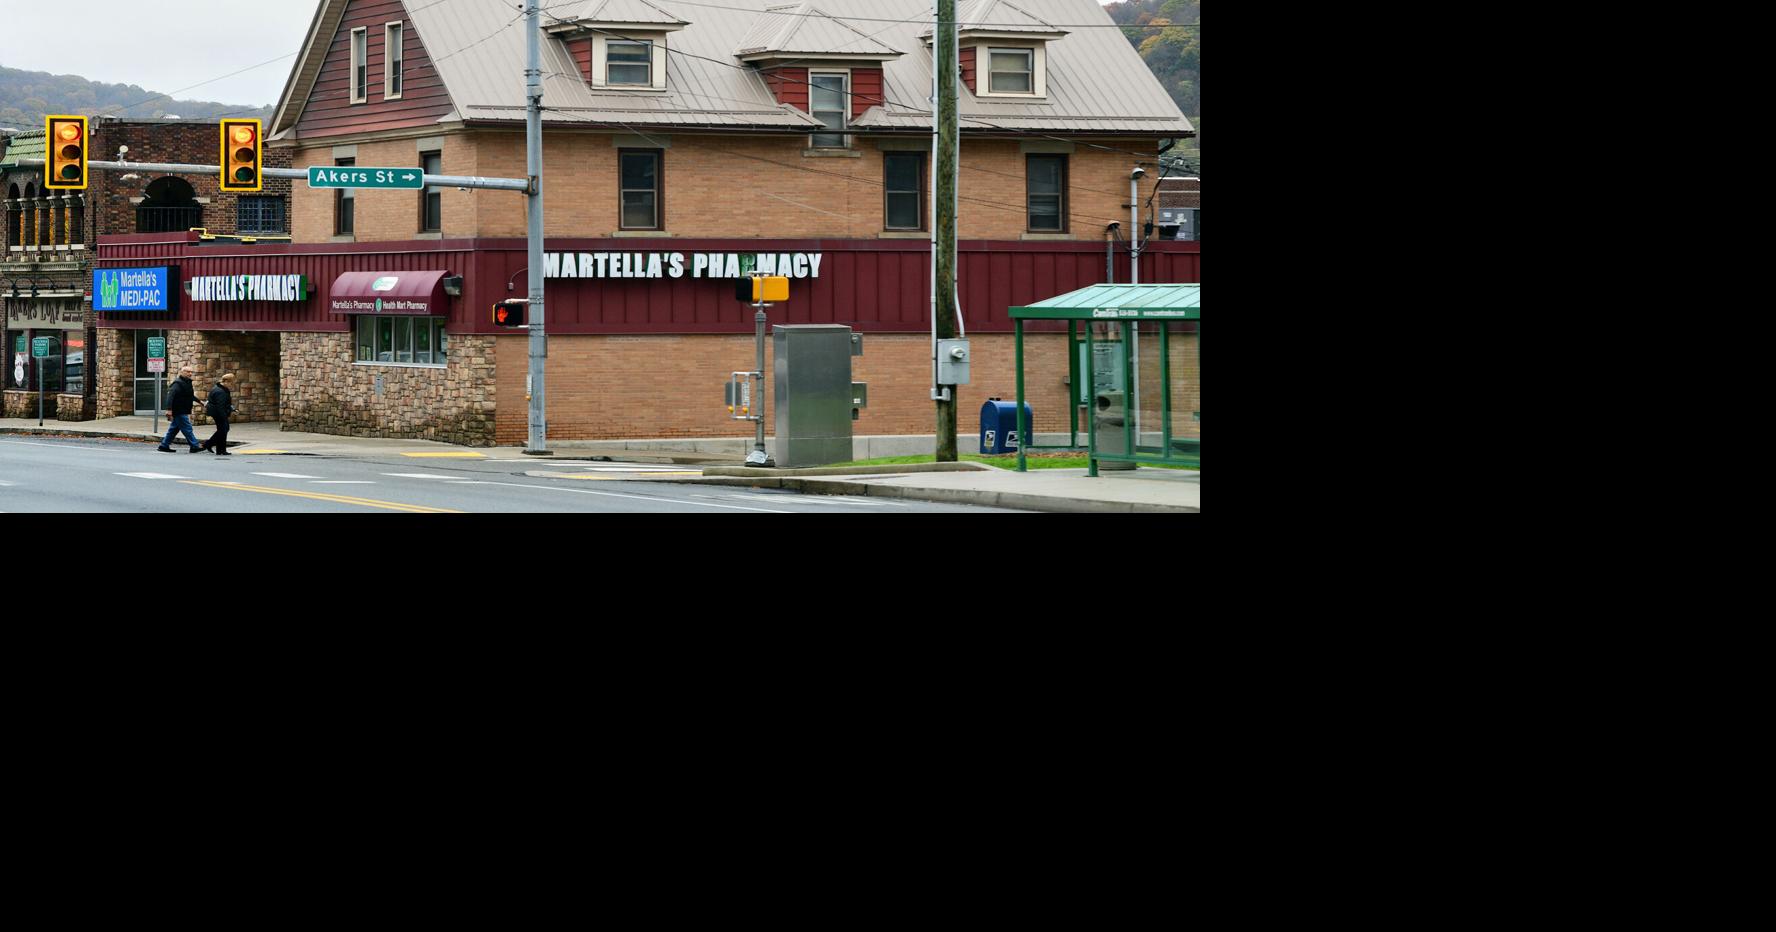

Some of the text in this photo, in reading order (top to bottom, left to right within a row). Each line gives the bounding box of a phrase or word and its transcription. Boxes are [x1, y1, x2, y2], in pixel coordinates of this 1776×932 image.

[316, 170, 394, 183] Akers St
[543, 252, 822, 278] MARTELLA'S PHARMACY
[120, 270, 157, 288] Martella's
[191, 274, 301, 301] MARTELLA'S PHARMACY
[120, 289, 161, 307] MEDI-PAC
